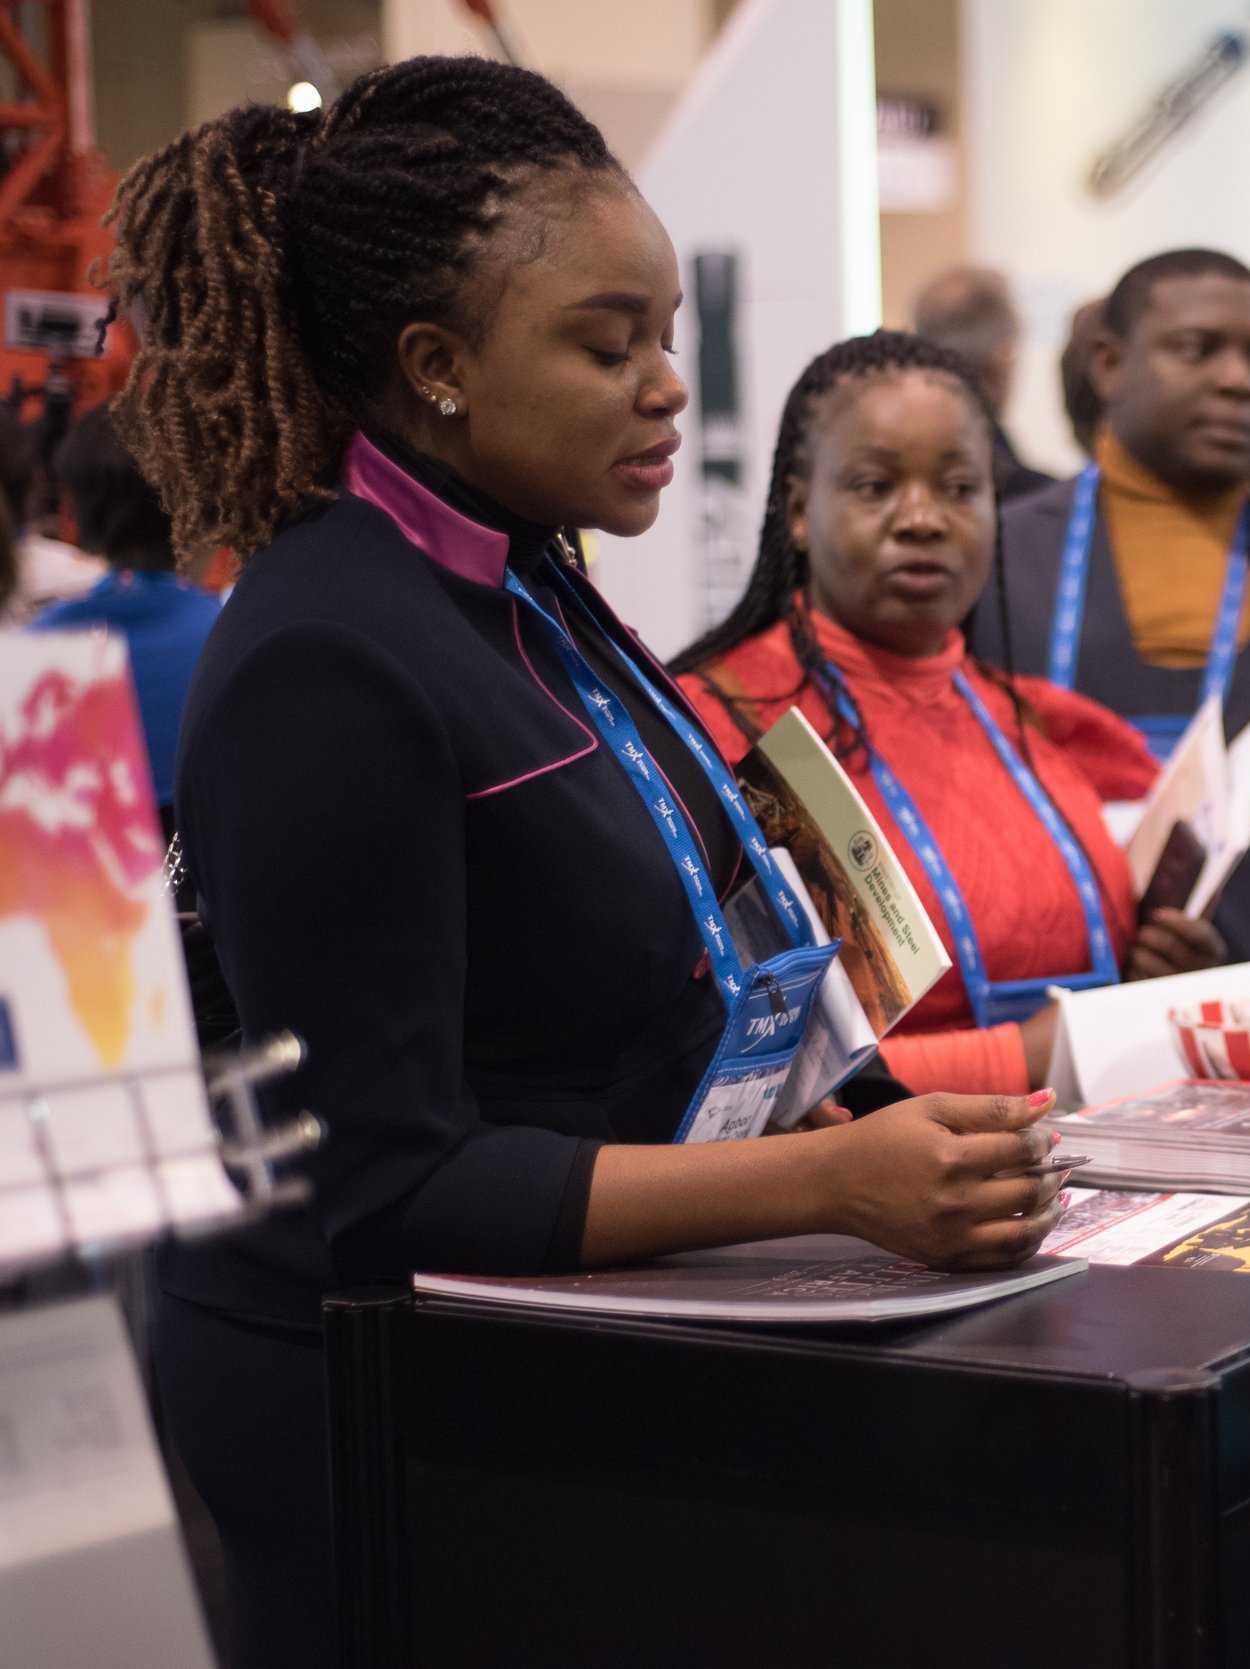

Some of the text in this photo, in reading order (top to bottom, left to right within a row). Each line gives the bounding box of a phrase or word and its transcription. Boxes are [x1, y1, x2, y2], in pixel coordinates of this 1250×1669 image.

[588, 688, 610, 708] TMX
[621, 741, 644, 762] TMX
[654, 797, 674, 821] TMX
[680, 854, 702, 880] TMX
[778, 889, 799, 913] TMX
[864, 874, 905, 946] Development
[871, 866, 892, 902] Mines
[890, 903, 904, 924] and
[902, 924, 920, 955] Steel
[704, 914, 722, 938] TMX
[723, 973, 741, 997] TMX
